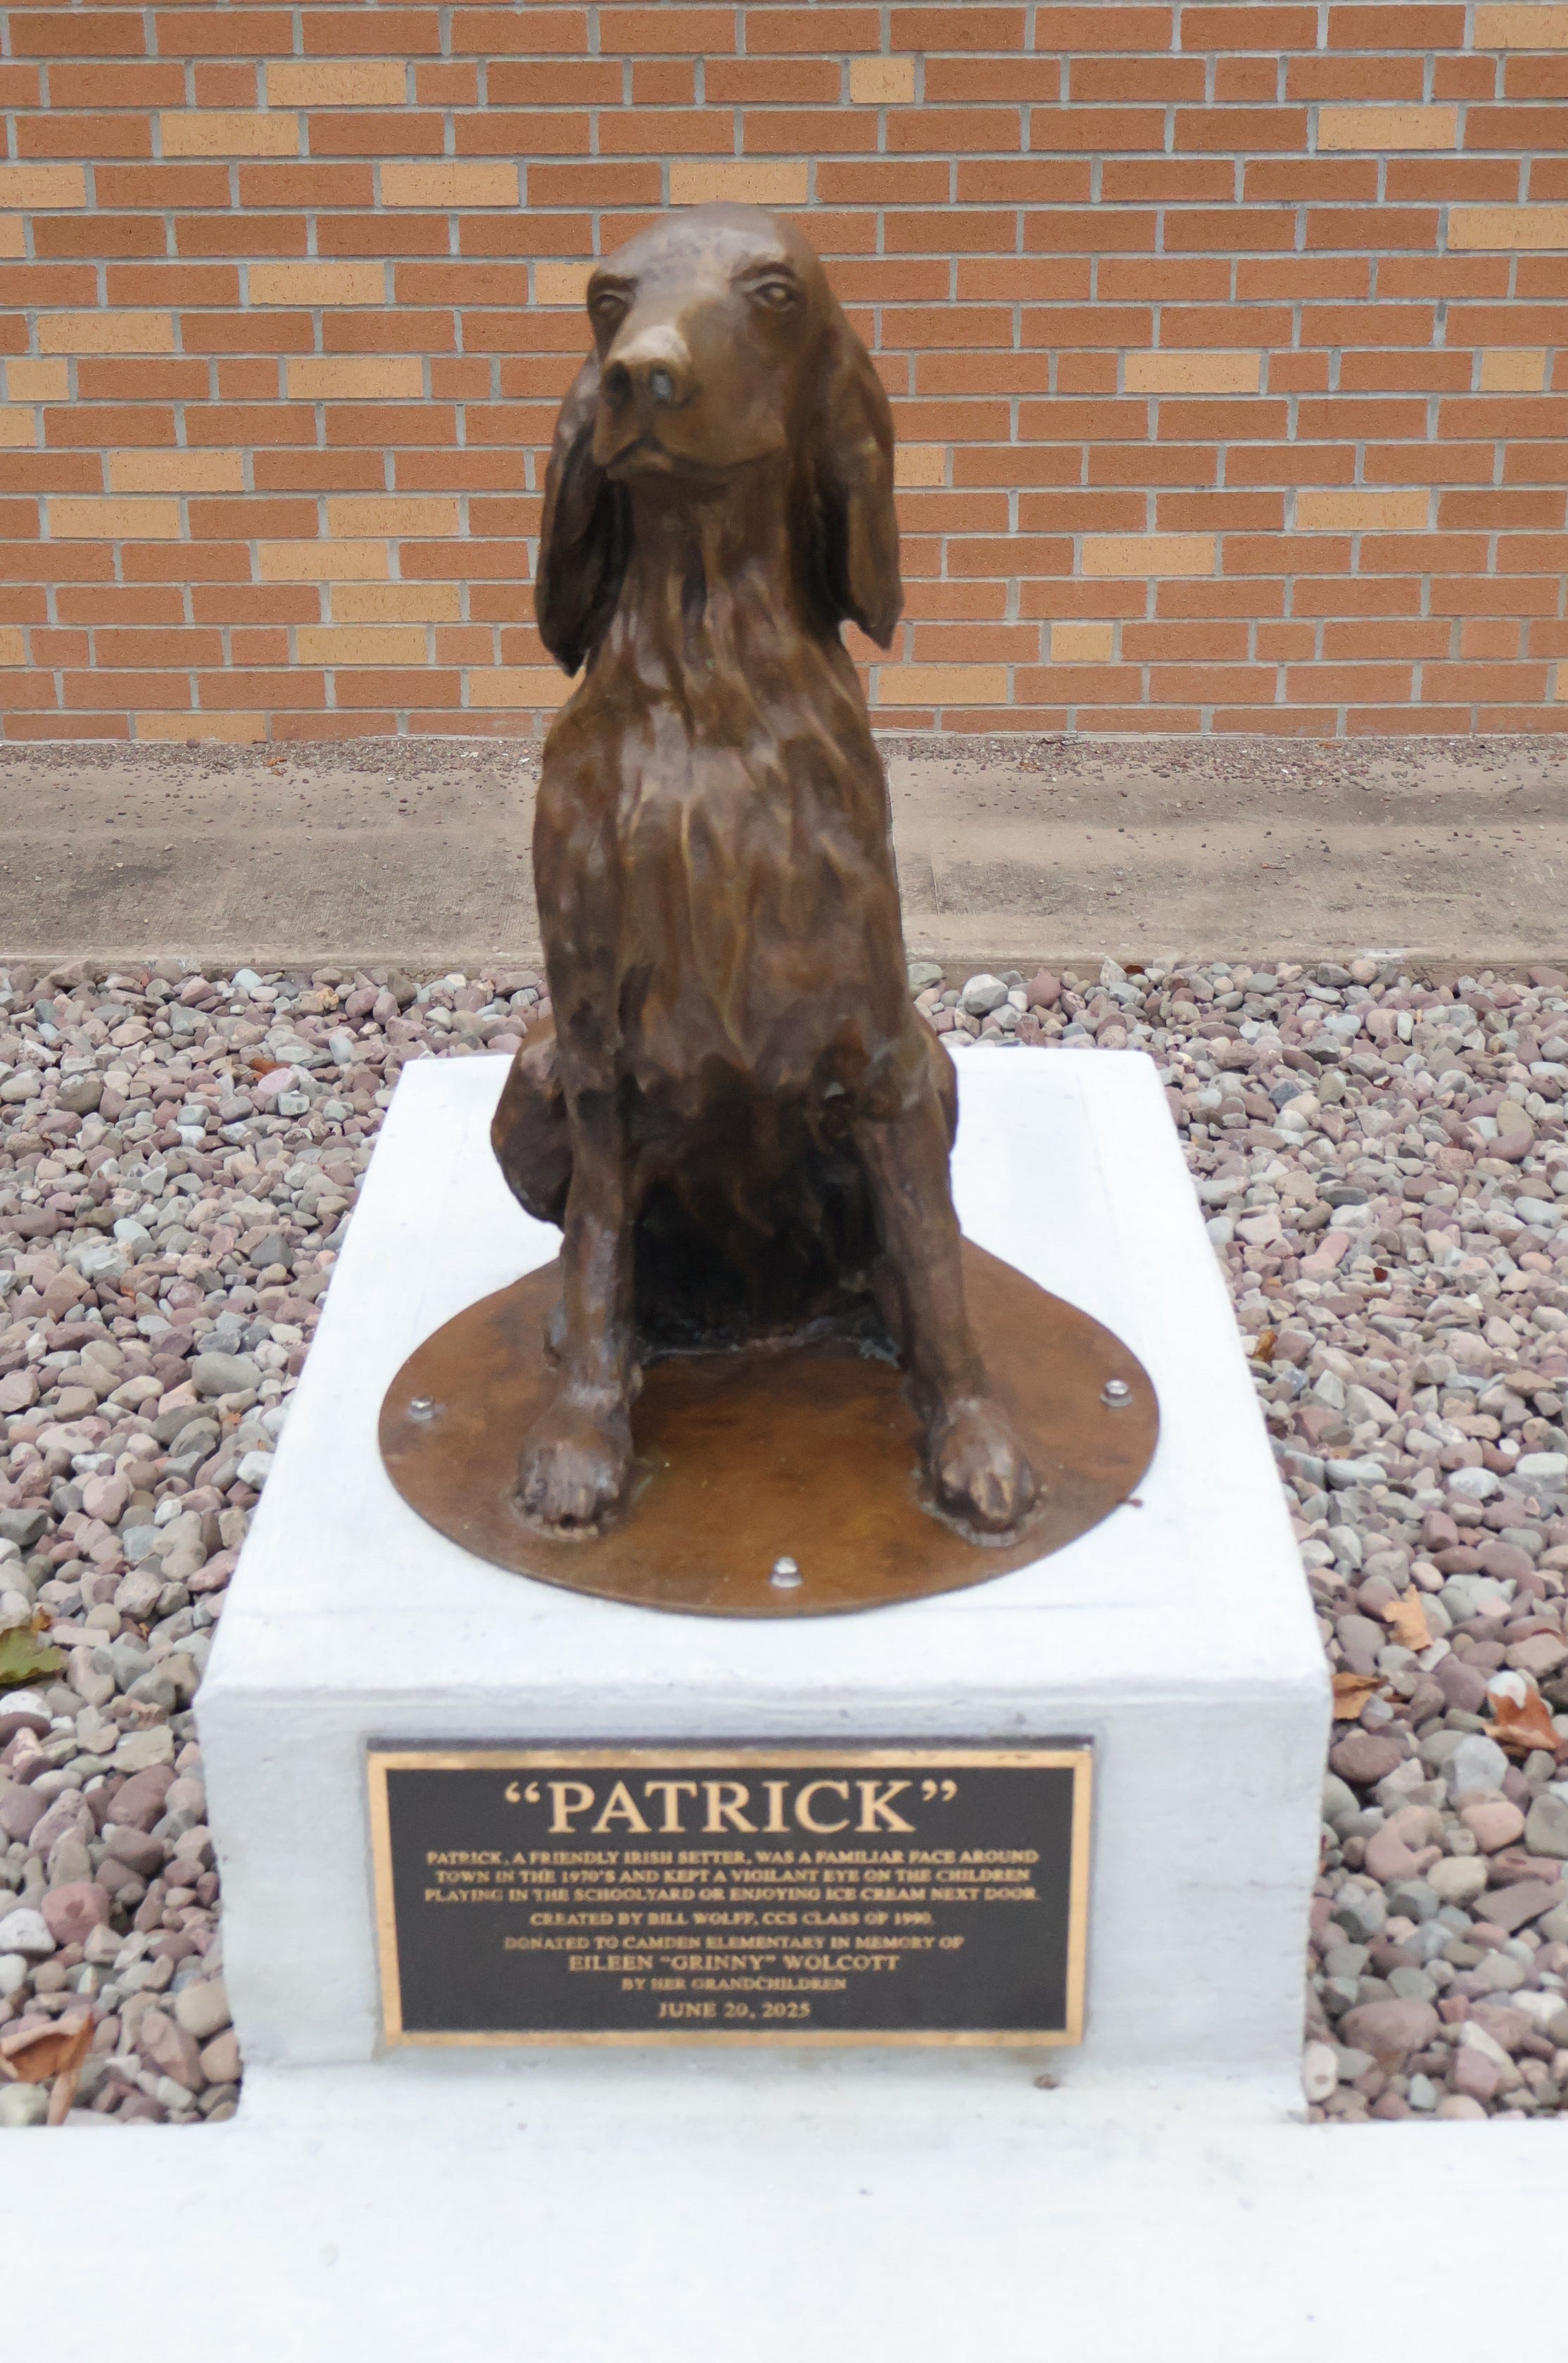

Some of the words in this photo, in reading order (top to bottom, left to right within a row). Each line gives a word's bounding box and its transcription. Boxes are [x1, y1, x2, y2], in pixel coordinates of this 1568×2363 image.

[505, 1779, 958, 1834] “PATRICK”
[512, 1851, 527, 1865] A
[530, 1851, 619, 1865] FRIENDLY
[624, 1851, 673, 1865] IRISH
[755, 1851, 794, 1865] WAS
[798, 1851, 812, 1865] A
[816, 1851, 906, 1865] FAMILIAR
[959, 1850, 1039, 1864] AROUND
[436, 1870, 490, 1884] TOWN
[495, 1870, 515, 1884] IN
[519, 1870, 556, 1884] THE
[619, 1870, 659, 1884] AND
[663, 1870, 709, 1884] KEPT
[713, 1870, 727, 1883] A
[731, 1870, 819, 1883] VIGILANT
[823, 1870, 860, 1883] EYE
[864, 1870, 892, 1883] ON
[896, 1869, 932, 1883] THE
[936, 1869, 1031, 1882] CHILDREN
[424, 1889, 502, 1902] PLAYING
[509, 1889, 529, 1901] IN
[532, 1889, 569, 1901] THE
[574, 1889, 695, 1901] SCHOOLYARD
[699, 1889, 725, 1901] OR
[730, 1888, 821, 1901] ENJOYING
[826, 1888, 856, 1901] ICE
[861, 1888, 925, 1901] CREAM
[930, 1888, 980, 1900] NEXT
[530, 1913, 614, 1927] CREATED
[618, 1913, 643, 1926] BY
[648, 1913, 690, 1926] BILL
[762, 1913, 797, 1925] CCS
[802, 1913, 860, 1925] CLASS
[864, 1913, 888, 1925] OF
[505, 1937, 590, 1951] DONATED
[595, 1937, 619, 1950] TO
[623, 1937, 701, 1950] CAMDEN
[705, 1937, 826, 1950] ELEMENTARY
[830, 1937, 850, 1949] IN
[854, 1937, 935, 1949] MEMORY
[939, 1936, 965, 1950] OF
[569, 1955, 654, 1972] EILEEN
[783, 1955, 900, 1970] WOLCOTT
[621, 1978, 646, 1991] BY
[650, 1978, 687, 1991] HER
[691, 1978, 847, 1991] GRANDCHILDREN
[657, 2003, 716, 2019] JUNE
[723, 2002, 756, 2019] 20,
[762, 2002, 811, 2019] 2025
